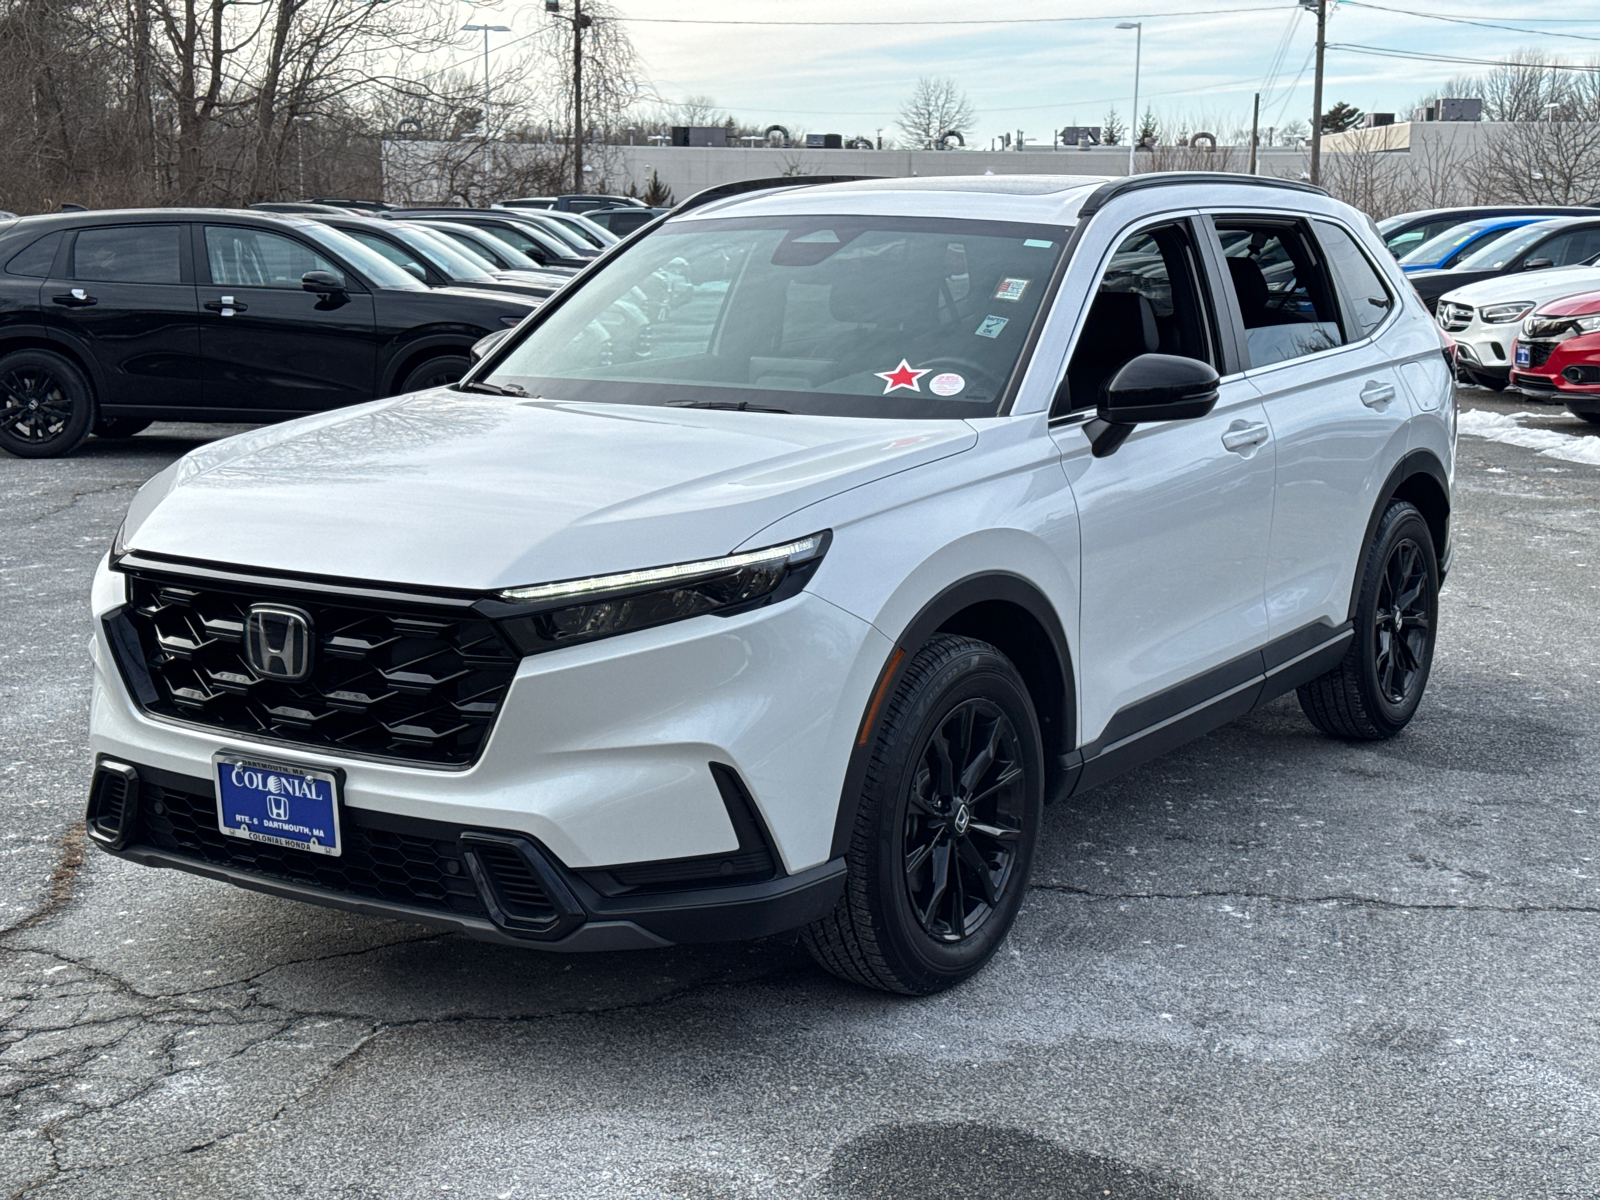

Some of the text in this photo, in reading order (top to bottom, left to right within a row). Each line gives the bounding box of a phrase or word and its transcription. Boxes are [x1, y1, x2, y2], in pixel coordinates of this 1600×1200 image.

[292, 768, 304, 776] MA
[231, 769, 323, 800] COLONIAL
[235, 814, 325, 837] RTE. 6 DARTMOUTH, MA
[248, 832, 311, 851] COLONIAL HONDA
